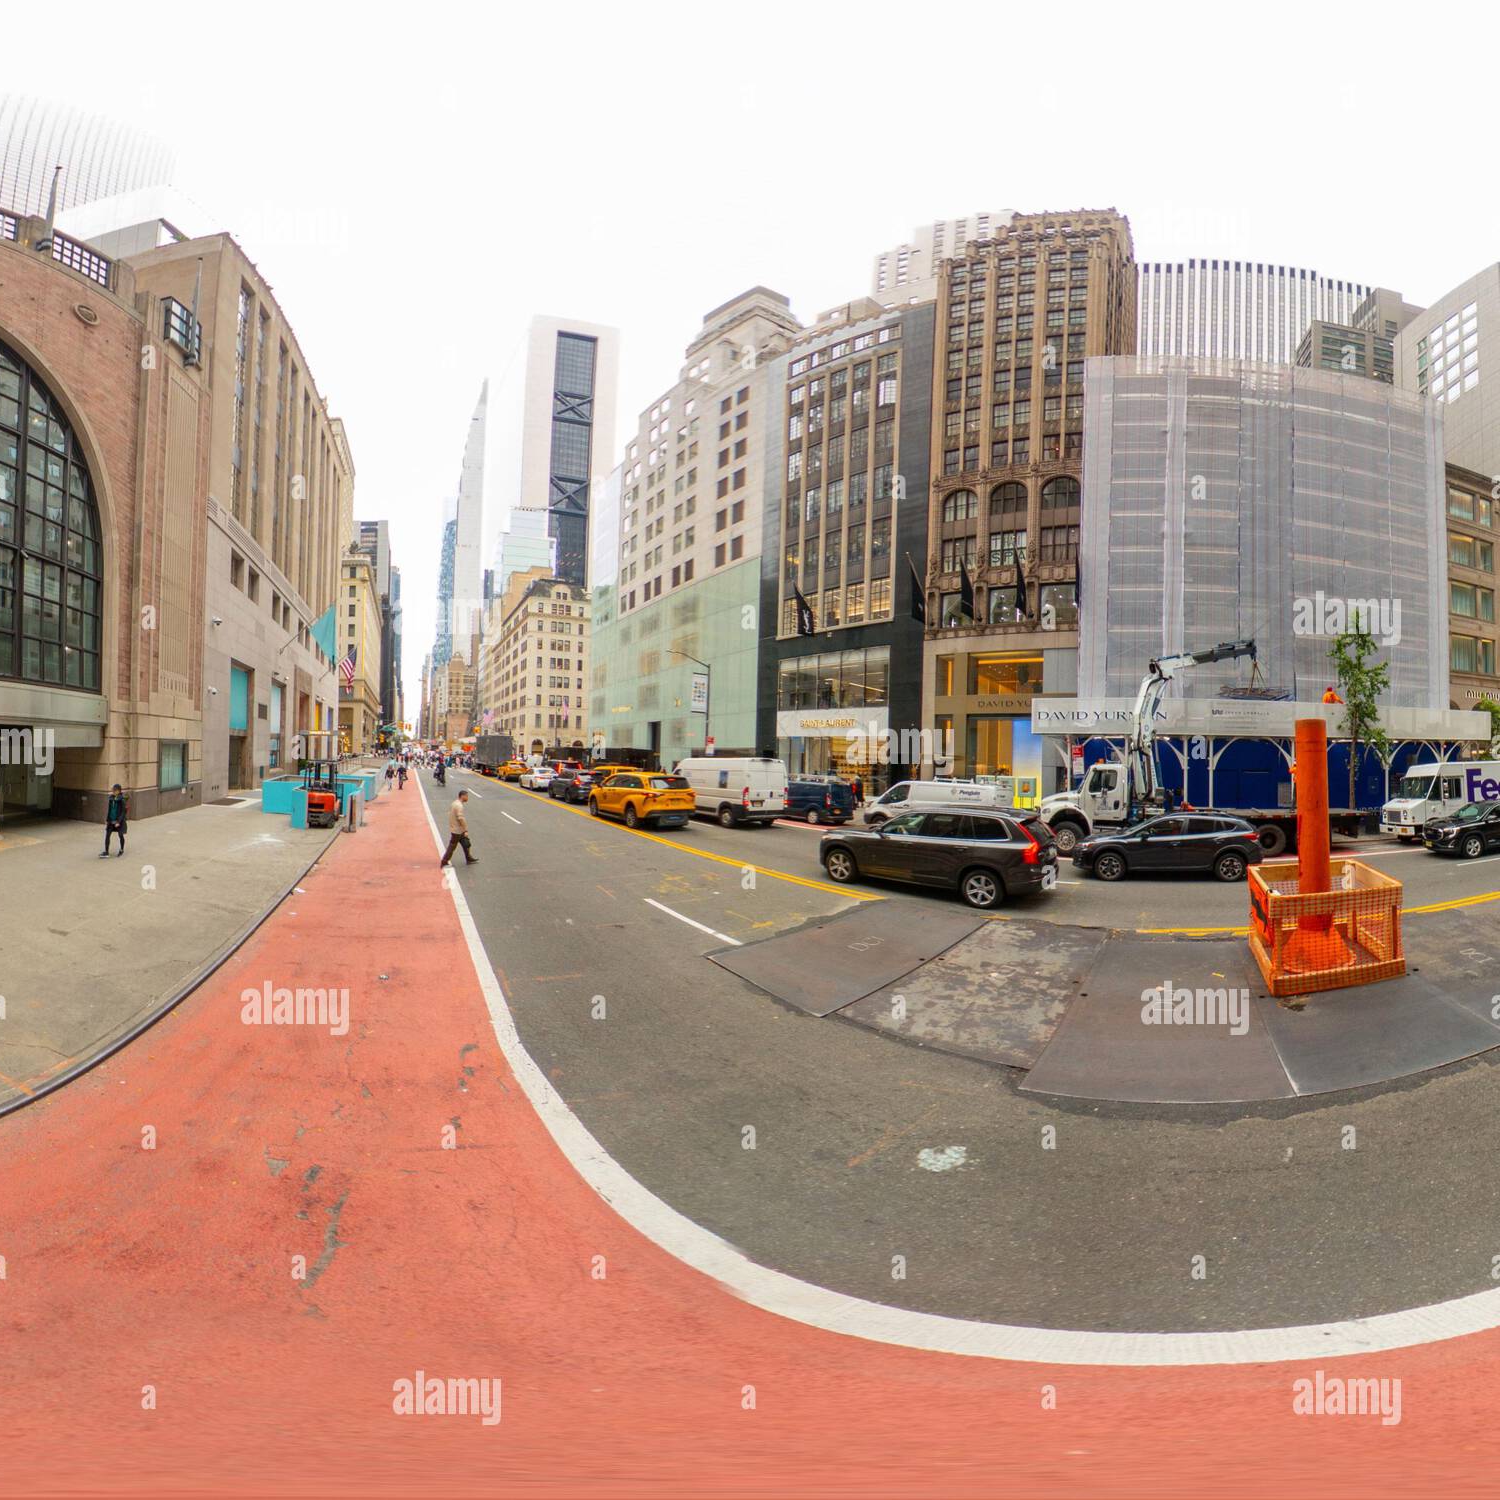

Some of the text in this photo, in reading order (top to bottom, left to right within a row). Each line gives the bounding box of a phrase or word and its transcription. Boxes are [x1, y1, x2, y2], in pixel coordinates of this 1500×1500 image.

[991, 551, 1026, 563] SPA
[1038, 711, 1088, 720] DAVID
[800, 719, 820, 728] SAINT
